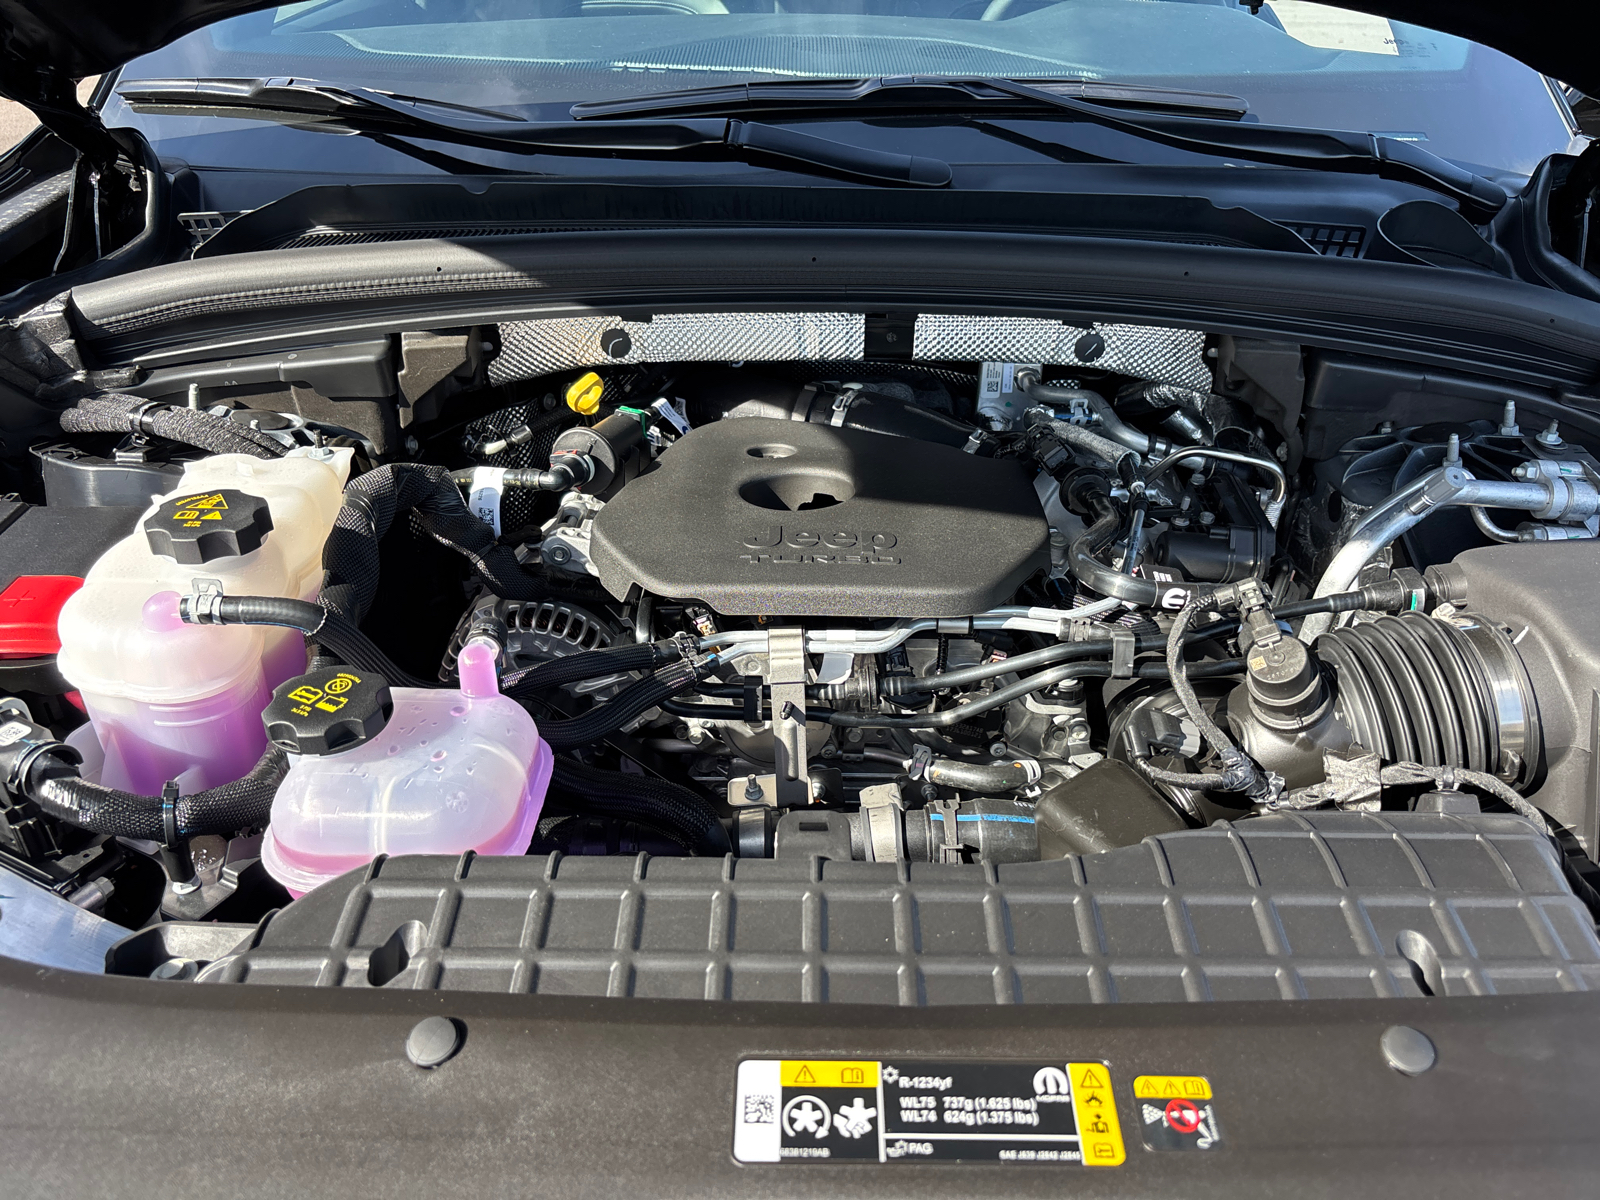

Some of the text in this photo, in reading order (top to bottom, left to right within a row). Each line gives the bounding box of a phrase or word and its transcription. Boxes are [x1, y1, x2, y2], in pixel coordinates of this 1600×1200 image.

[743, 525, 898, 554] Jeep
[740, 554, 902, 564] TURBO
[899, 1076, 953, 1091] R-1234yf
[900, 1096, 1037, 1111] WL75 737g (1.625 lbs)
[900, 1109, 1040, 1126] WL74 624g (1.375 lbs)
[908, 1142, 934, 1154] PAG
